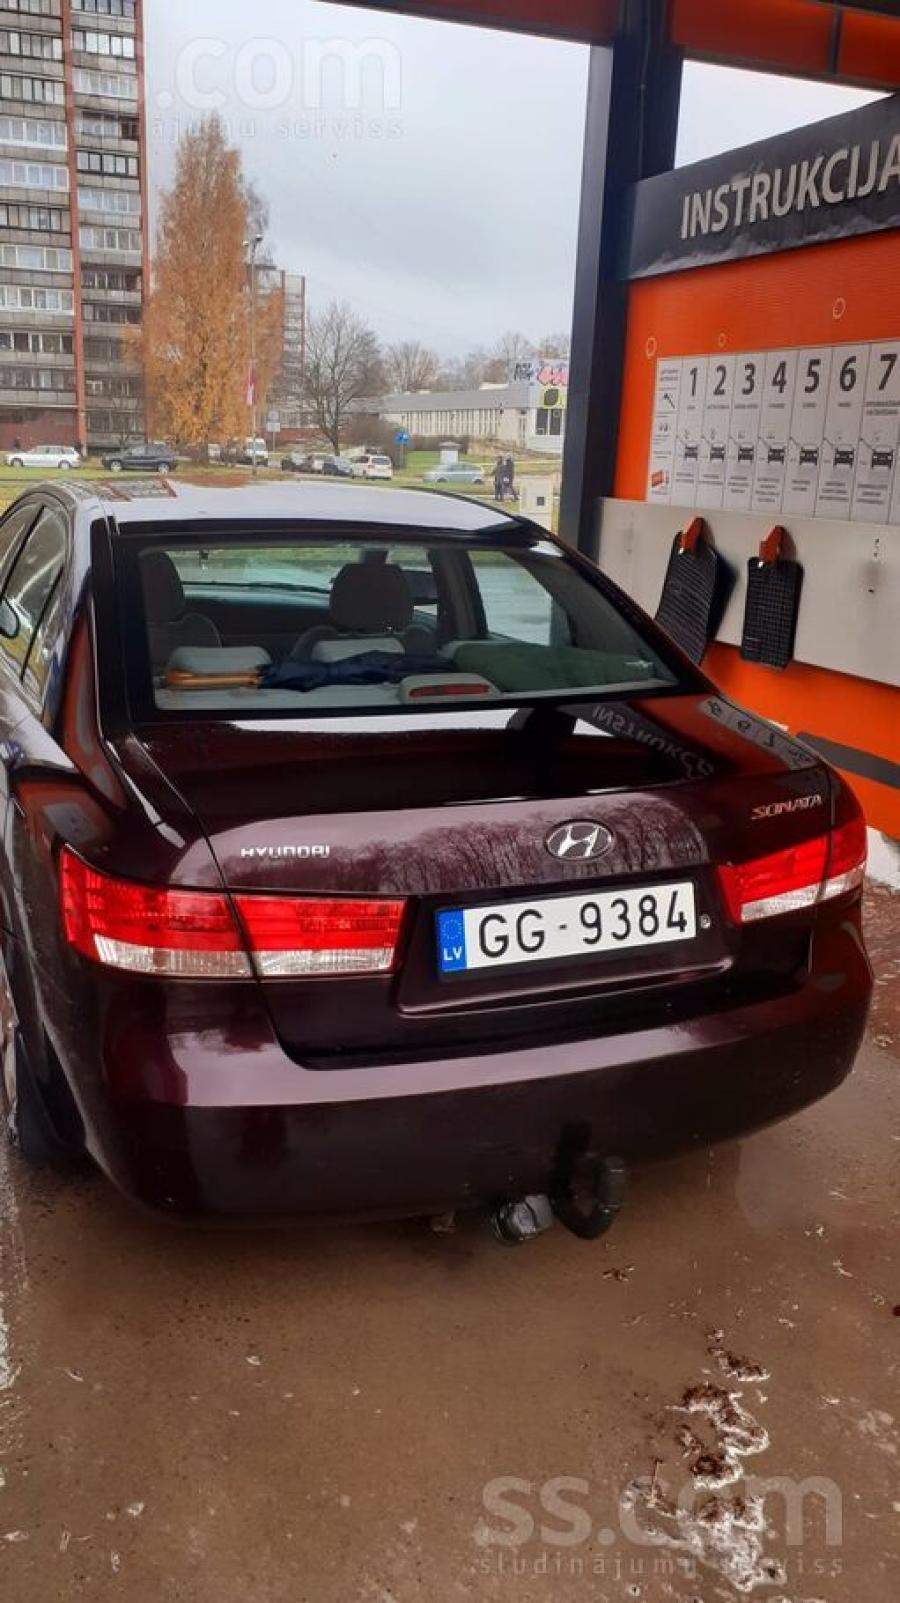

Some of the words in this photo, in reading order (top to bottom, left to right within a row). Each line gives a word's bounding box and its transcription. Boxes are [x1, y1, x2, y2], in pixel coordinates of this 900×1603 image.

[689, 367, 698, 397] 1
[713, 365, 727, 396] 2
[741, 362, 756, 396] 3
[771, 360, 787, 394] 4
[804, 358, 821, 394] 5
[839, 355, 857, 392] 6
[878, 353, 898, 391] 7
[751, 794, 822, 820] SONATA
[240, 845, 330, 859] HYUNDAI
[443, 947, 462, 962] LV
